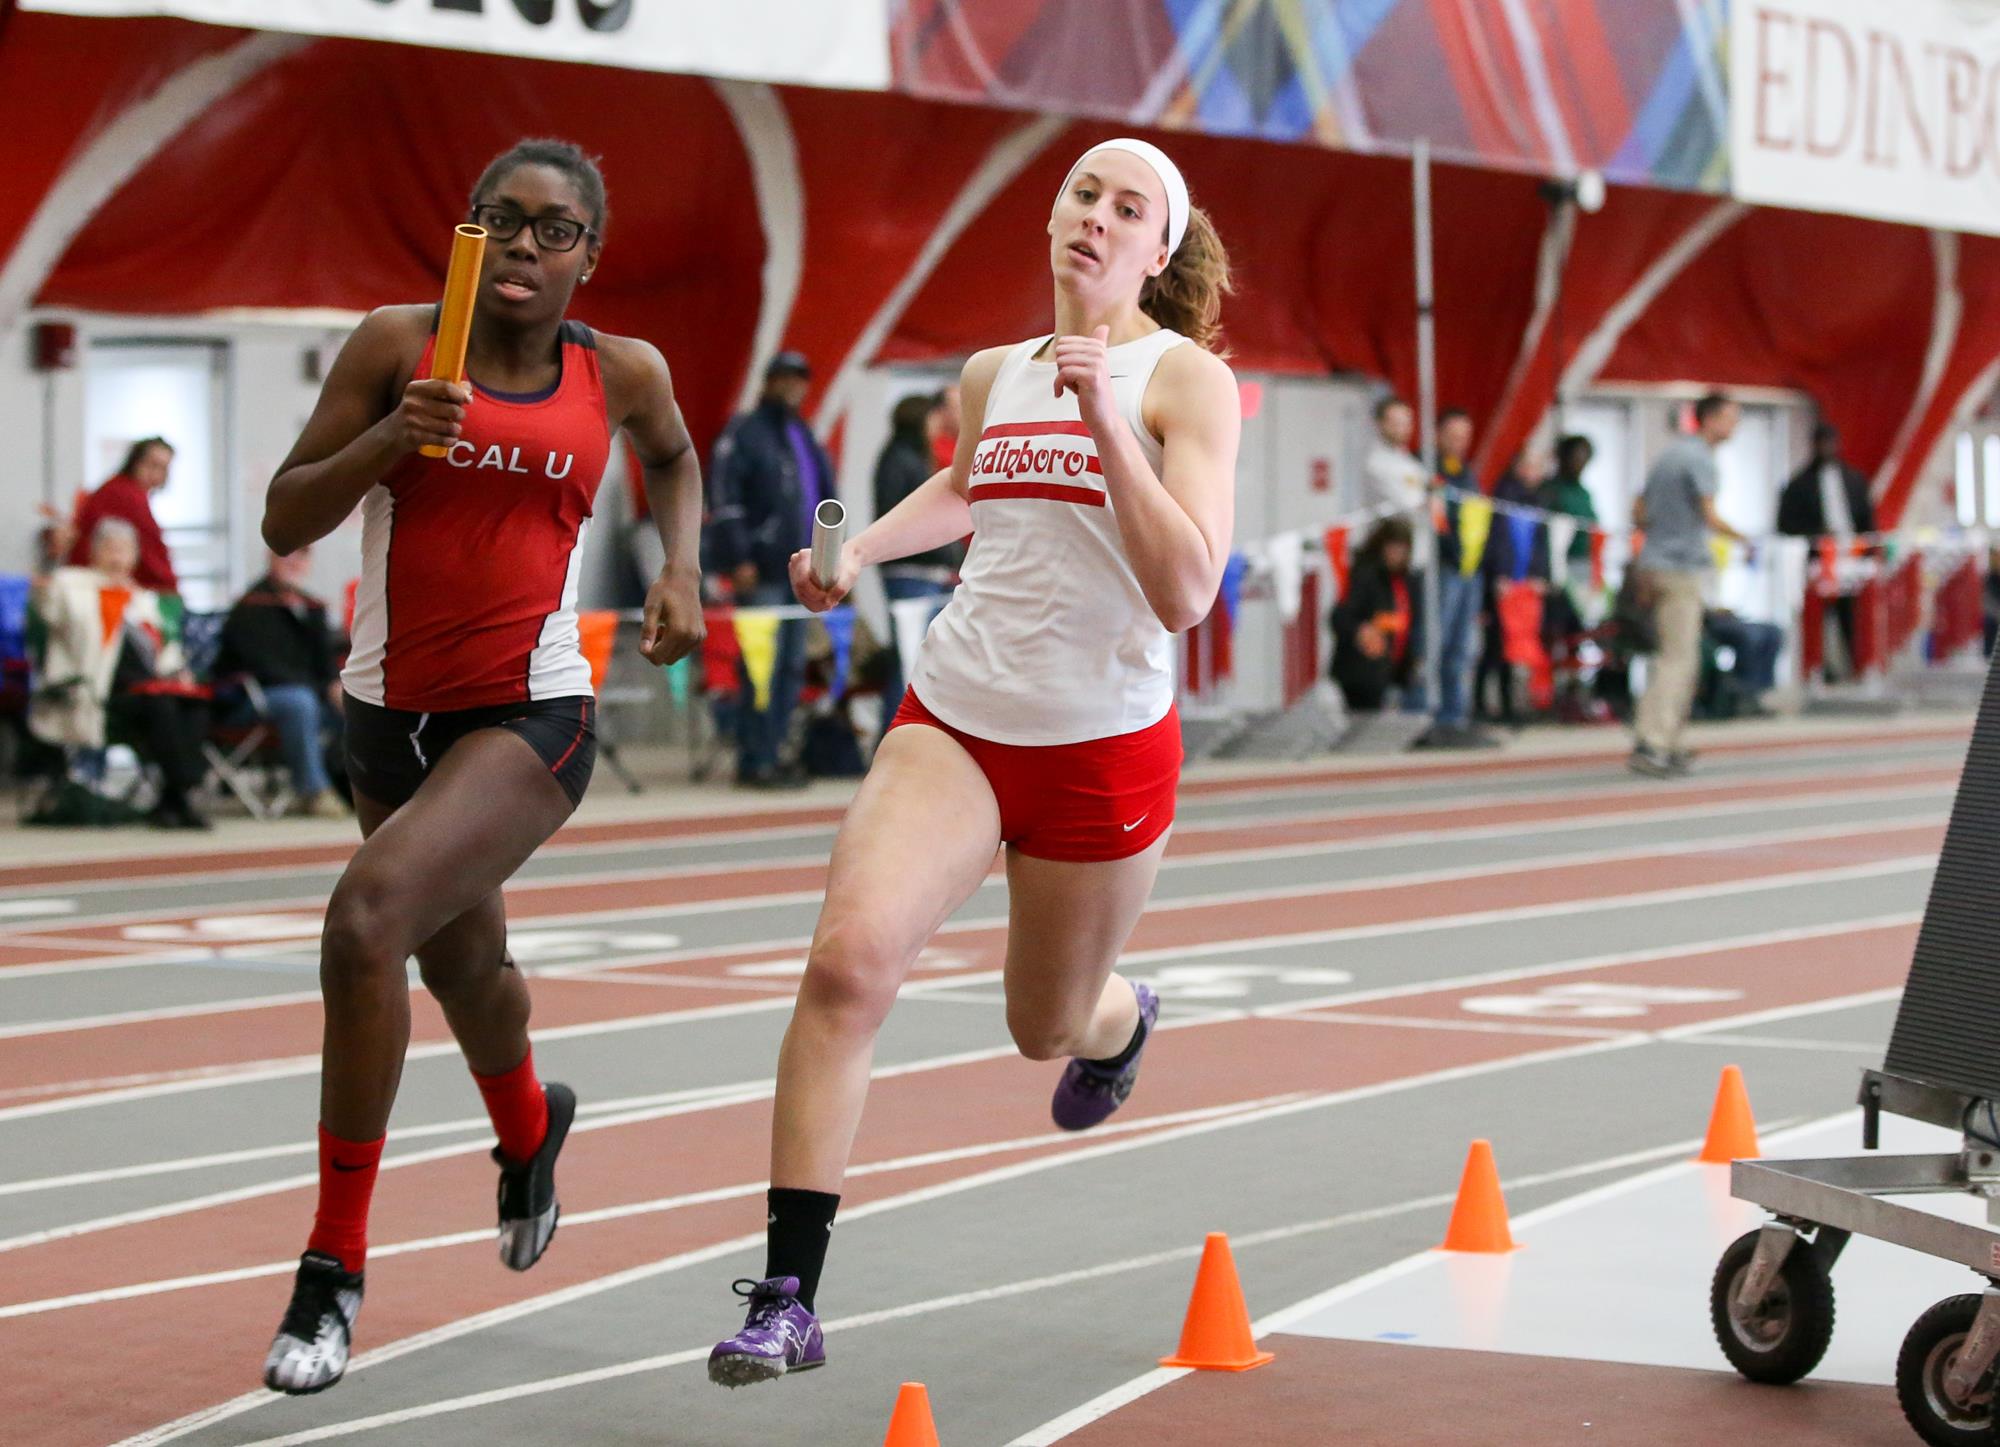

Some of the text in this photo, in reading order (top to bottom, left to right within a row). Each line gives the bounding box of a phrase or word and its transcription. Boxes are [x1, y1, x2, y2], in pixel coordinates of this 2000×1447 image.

[446, 440, 574, 480] CAL U
[972, 440, 1084, 480] edinboro
